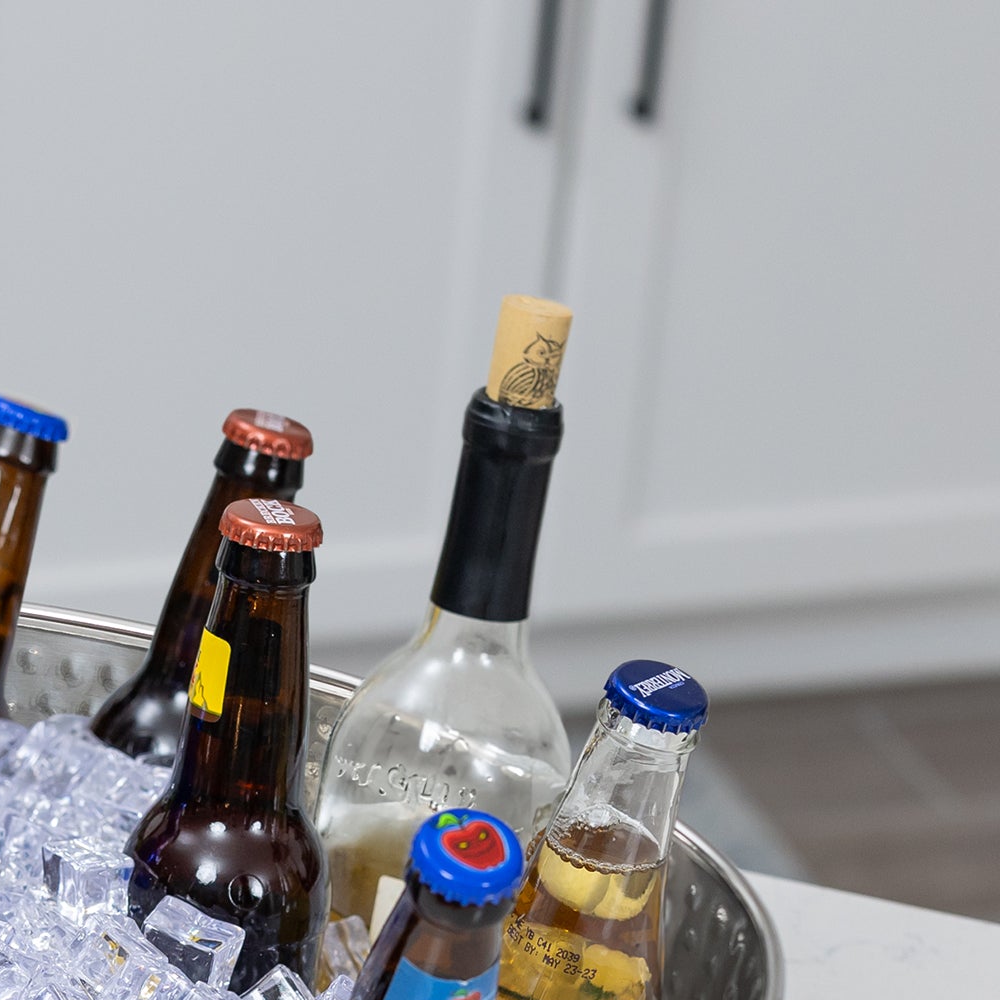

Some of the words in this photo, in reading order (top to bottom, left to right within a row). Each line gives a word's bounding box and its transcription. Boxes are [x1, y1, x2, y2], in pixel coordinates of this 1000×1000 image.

[261, 499, 296, 525] BOCK
[635, 667, 691, 698] MONTERREY
[507, 924, 524, 944] BEST
[524, 942, 539, 956] BY:
[542, 954, 561, 969] MAY
[563, 963, 597, 980] 23-23
[556, 948, 581, 963] 2039
